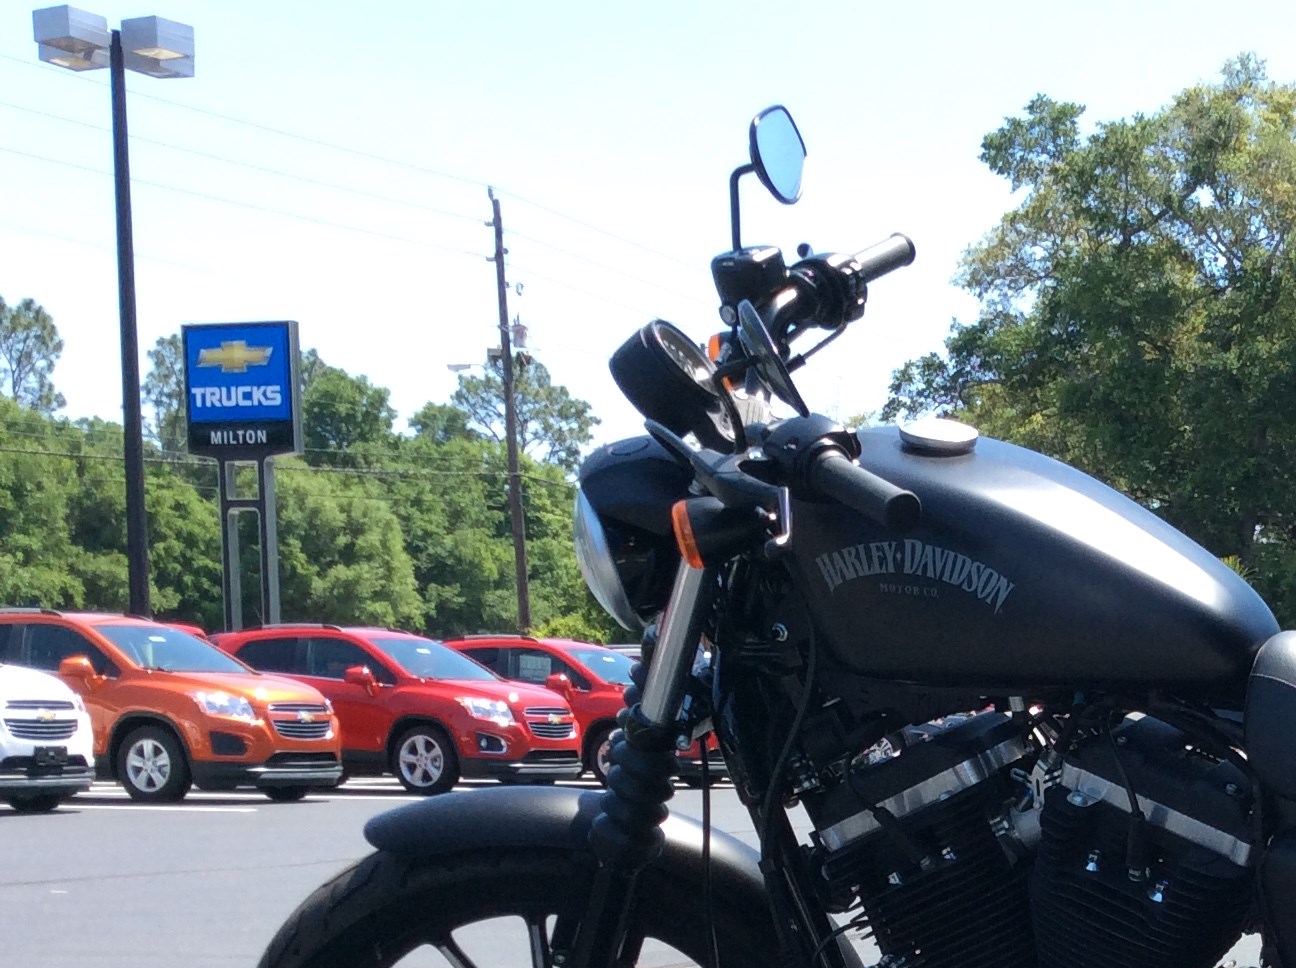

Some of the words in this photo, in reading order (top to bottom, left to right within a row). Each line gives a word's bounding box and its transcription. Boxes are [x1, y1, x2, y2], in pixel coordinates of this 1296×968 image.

[191, 385, 282, 408] TRUCKS
[210, 429, 267, 445] MILTON
[880, 582, 920, 596] MOTOR
